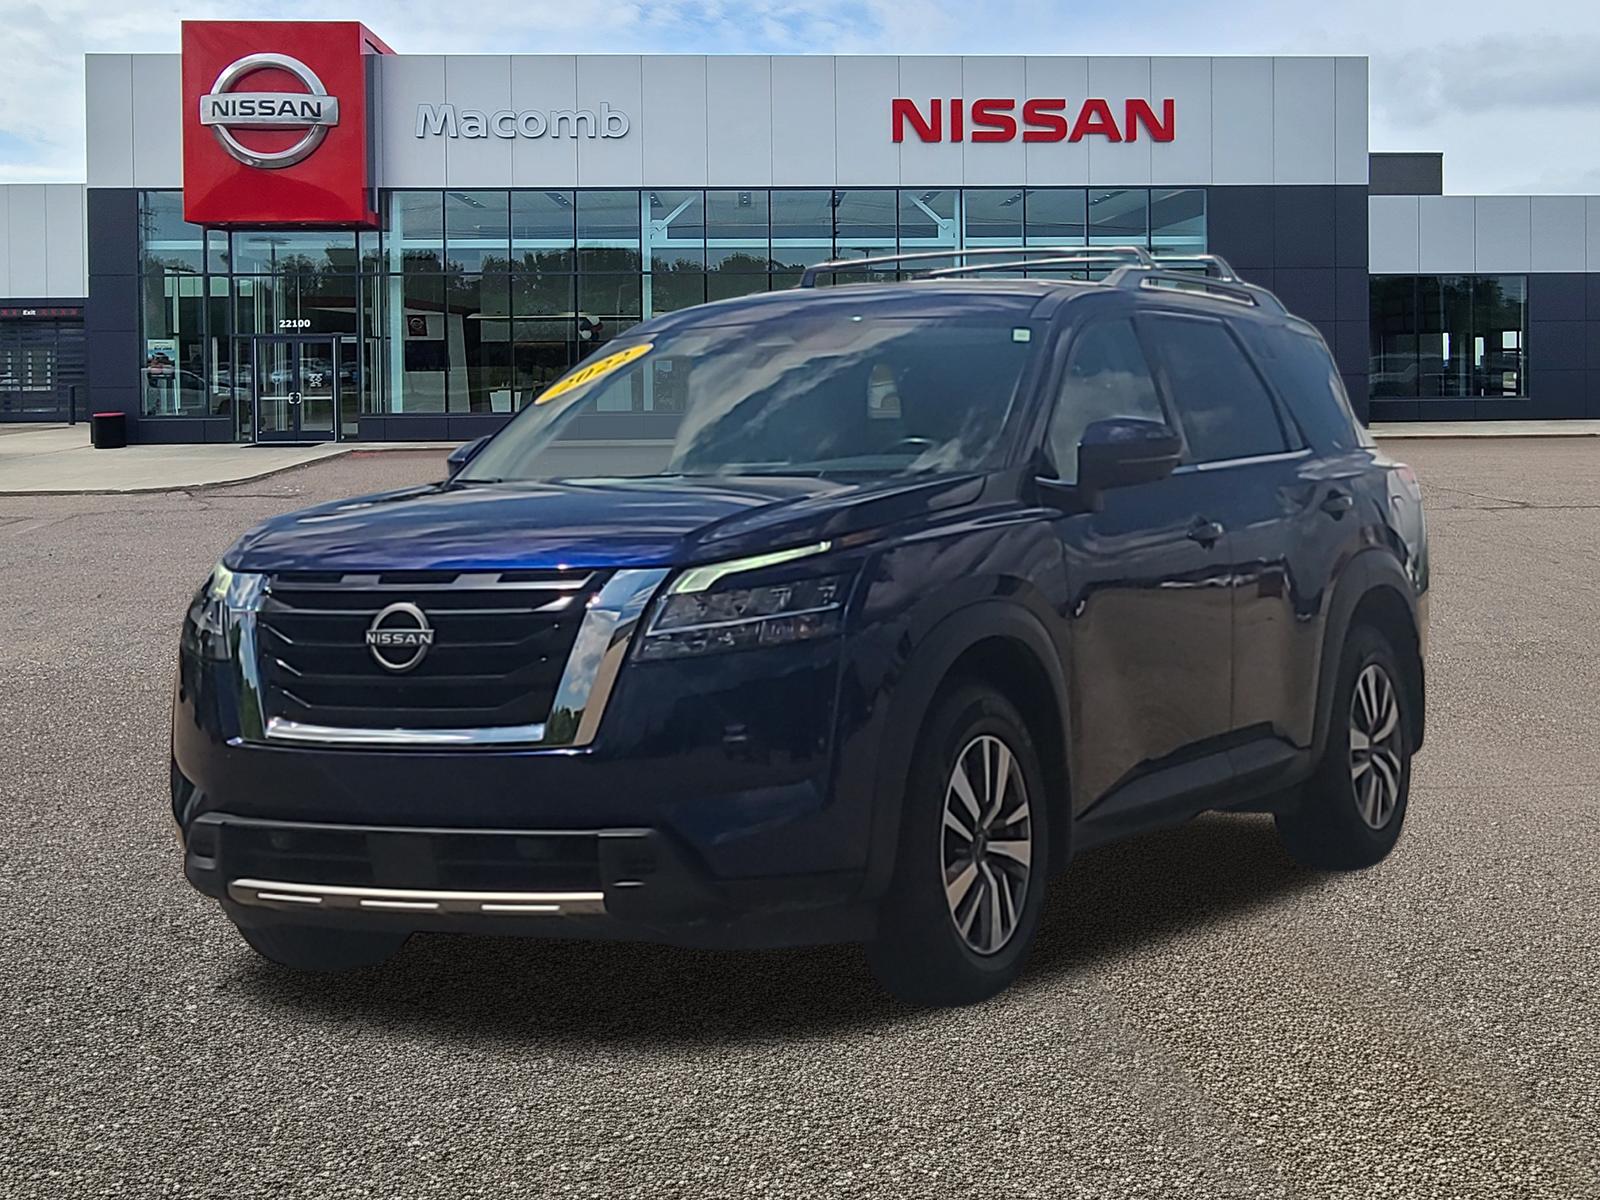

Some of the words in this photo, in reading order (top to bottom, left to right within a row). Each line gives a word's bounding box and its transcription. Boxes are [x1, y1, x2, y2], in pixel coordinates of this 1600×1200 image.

[212, 100, 322, 118] NISSAN
[415, 102, 630, 139] Macomb
[891, 98, 1175, 143] NISSAN
[279, 319, 311, 328] 22100
[366, 633, 432, 644] NISSAN
